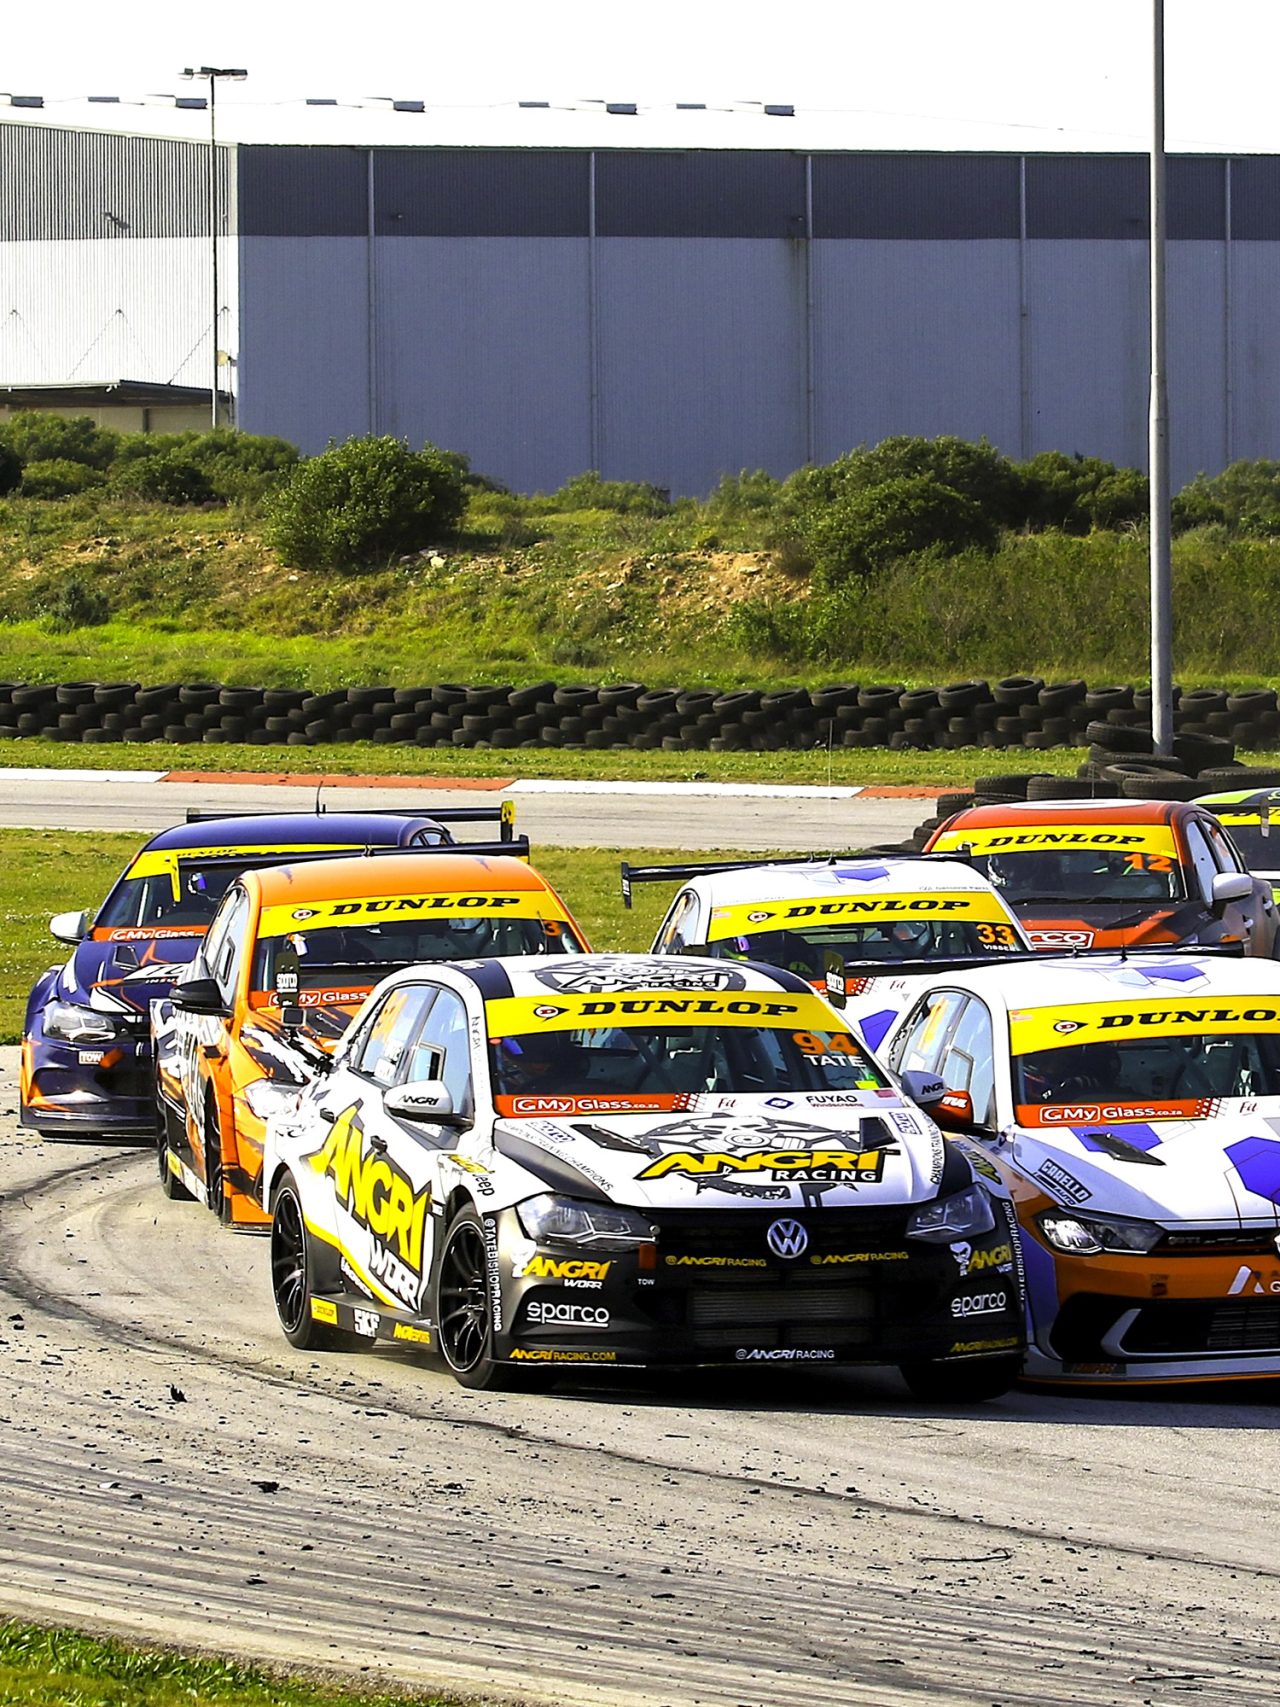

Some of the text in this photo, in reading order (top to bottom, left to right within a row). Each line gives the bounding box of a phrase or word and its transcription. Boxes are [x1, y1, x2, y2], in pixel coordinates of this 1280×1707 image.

[984, 833, 1146, 848] DUNLOP
[1123, 853, 1172, 872] 12
[328, 896, 521, 917] DUNLOP
[783, 899, 971, 919] DUNLOP
[976, 923, 1015, 945] 33
[578, 1000, 799, 1017] DUNLOP
[792, 1032, 859, 1057] 94
[803, 1054, 867, 1068] TATE
[399, 1094, 440, 1106] ANGRI
[805, 1095, 859, 1104] FUYAO
[637, 1149, 880, 1179] ANGRI
[776, 1170, 877, 1181] RACING
[1041, 1161, 1090, 1201] CARELLO
[307, 1104, 428, 1273] ANGRI
[523, 1255, 612, 1281] ANGRI
[968, 1242, 1013, 1273] ANGRI
[637, 1278, 656, 1287] TOW
[527, 1301, 610, 1327] sparco
[951, 1292, 1007, 1317] sparco
